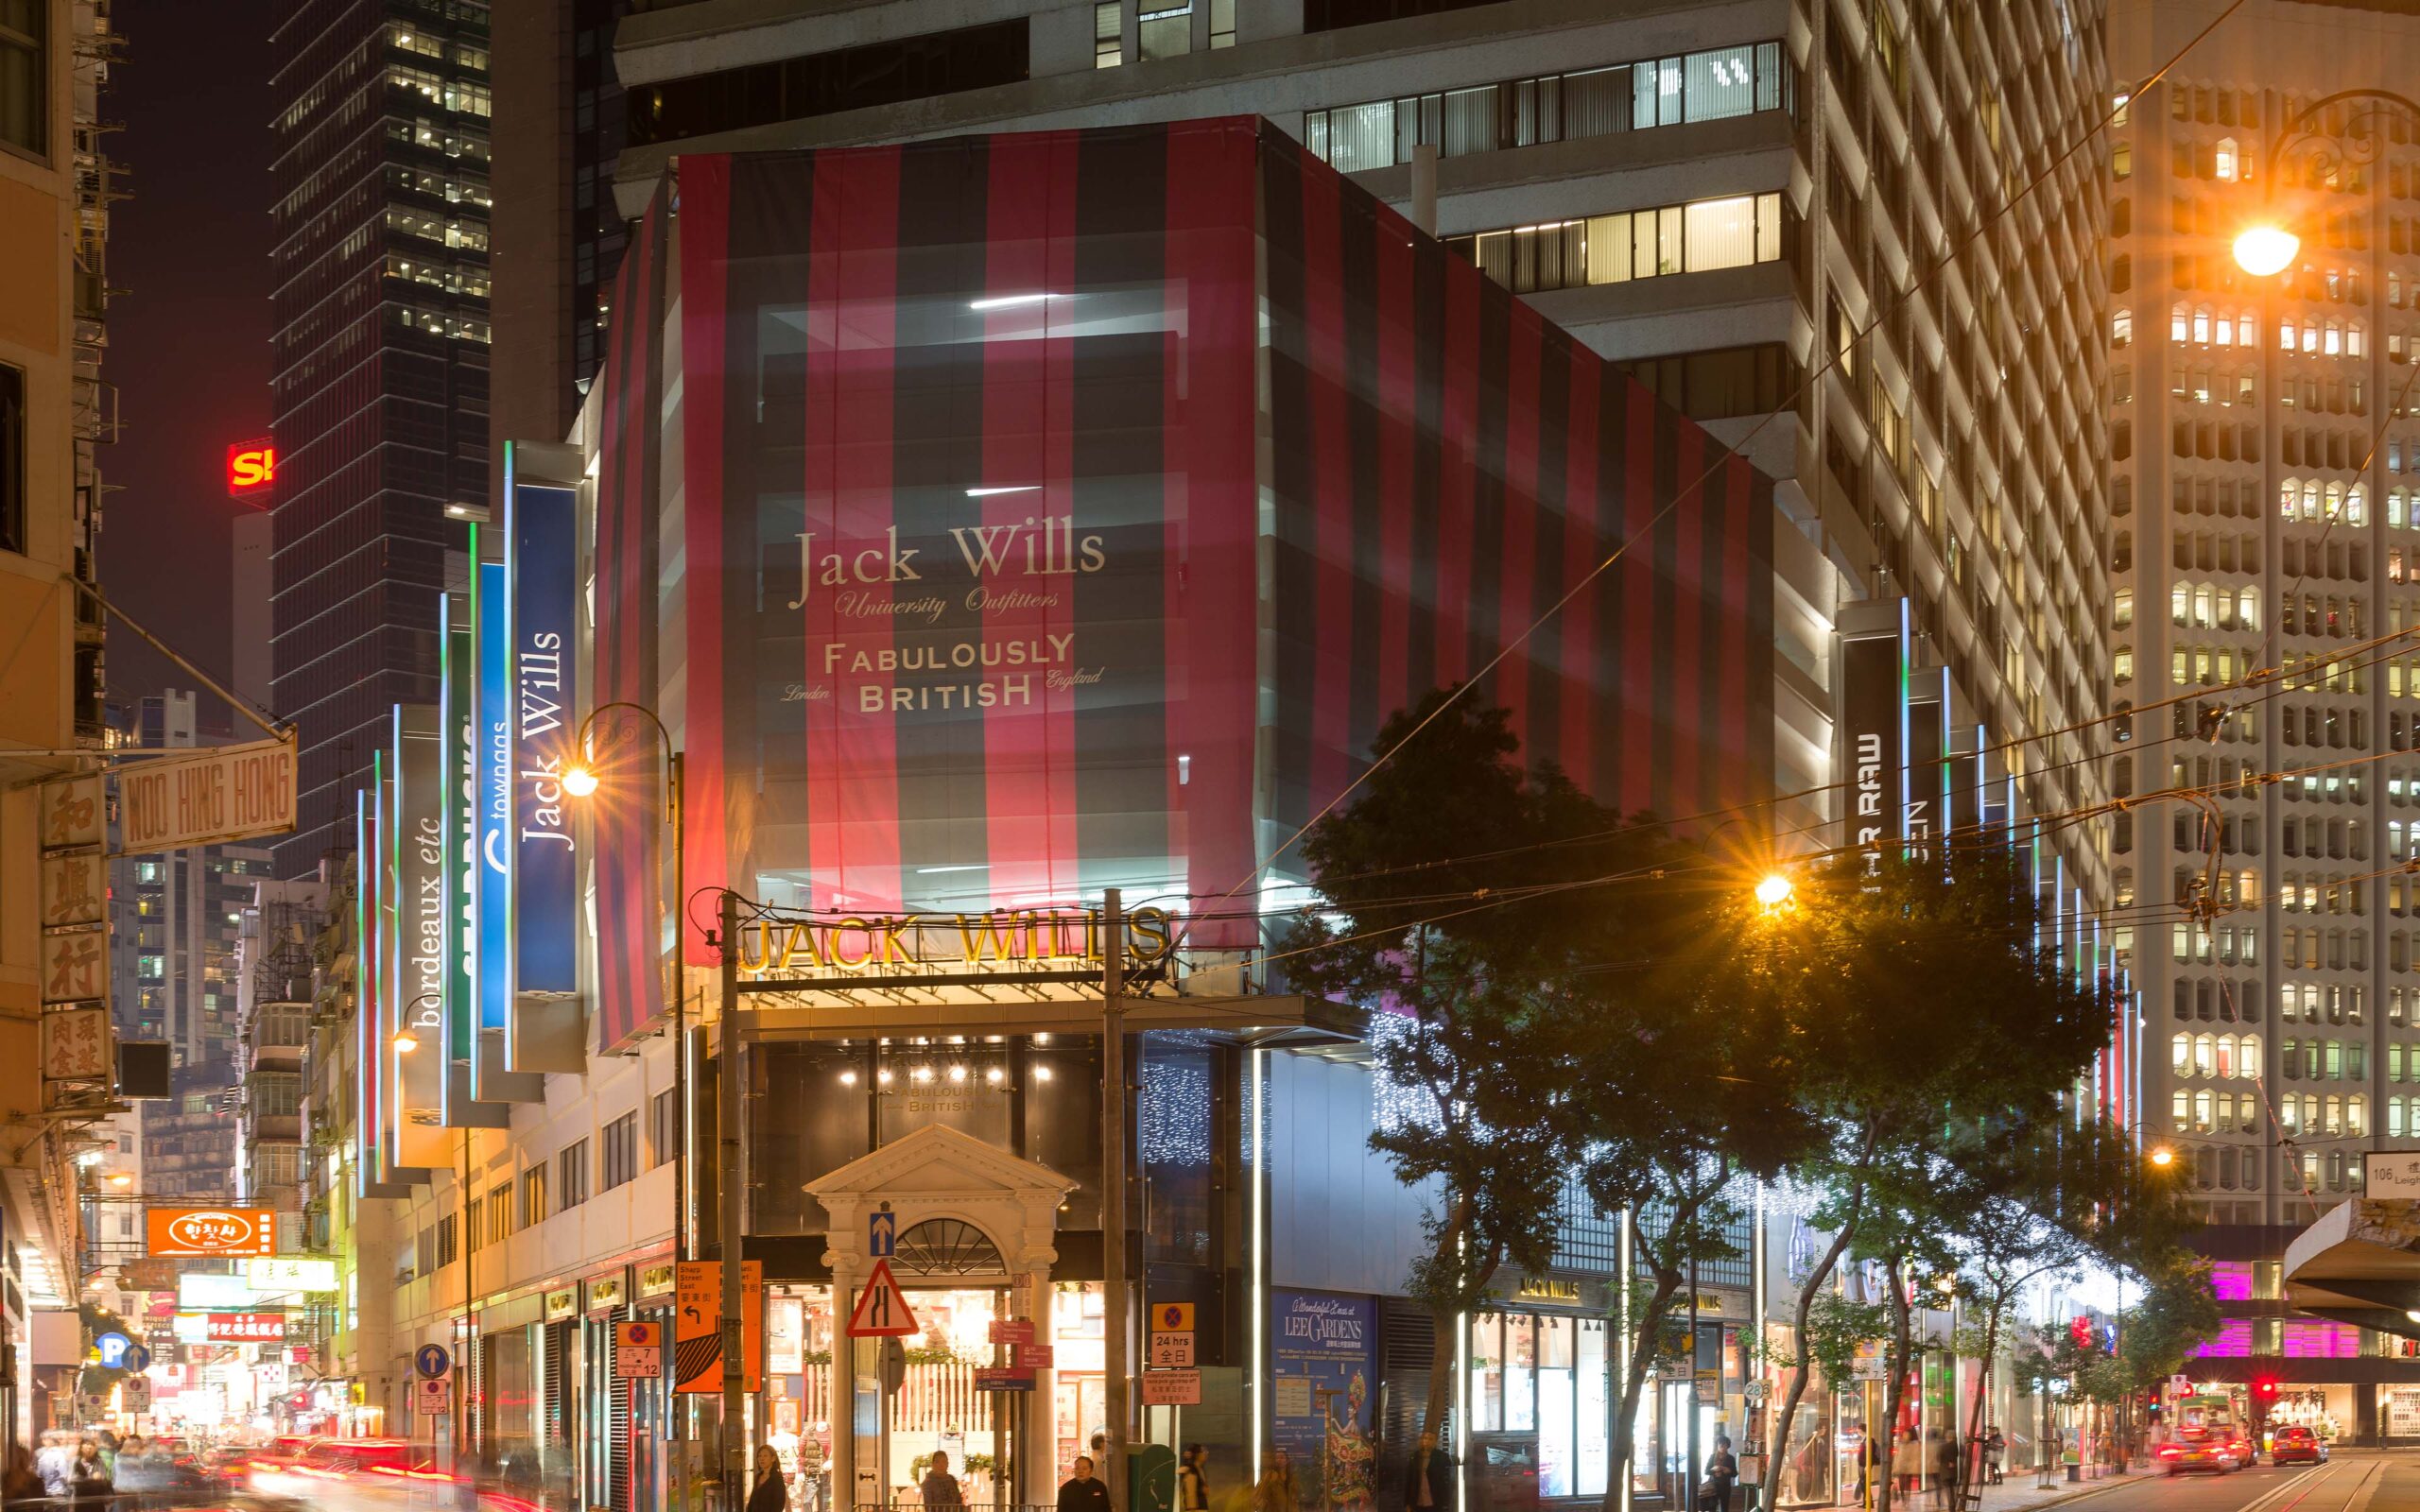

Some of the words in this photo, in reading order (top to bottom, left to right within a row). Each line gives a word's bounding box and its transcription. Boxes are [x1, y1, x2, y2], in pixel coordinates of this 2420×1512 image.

[787, 524, 922, 611] Jack
[948, 515, 1106, 577] Wills
[834, 590, 947, 625] University
[965, 585, 1059, 616] Outfitters
[824, 632, 1076, 675] FABULOUSLY
[520, 631, 562, 740] Wills
[779, 683, 831, 703] London
[859, 674, 1030, 713] BRITISH
[1046, 666, 1106, 693] England
[1858, 733, 1882, 816] RAW
[127, 772, 169, 843] WOO
[177, 763, 225, 836] HING
[233, 752, 290, 827] HONG
[521, 755, 575, 852] Jack
[415, 817, 441, 866] etc
[412, 875, 441, 1028] bordeaux
[739, 915, 921, 975] JACK
[957, 905, 1170, 967] WILLS
[909, 1101, 975, 1113] BRITISH
[2375, 1168, 2393, 1180] 106
[680, 1265, 701, 1274] Sharp
[1550, 1280, 1580, 1300] WILLS
[1156, 1336, 1170, 1347] 24
[1172, 1336, 1189, 1347] hrs
[1285, 1315, 1308, 1337] LEE
[1308, 1313, 1362, 1342] GARDENS
[103, 1338, 126, 1364] P
[644, 1348, 651, 1359] 7
[1161, 1349, 1185, 1364] 全日
[644, 1365, 658, 1375] 12
